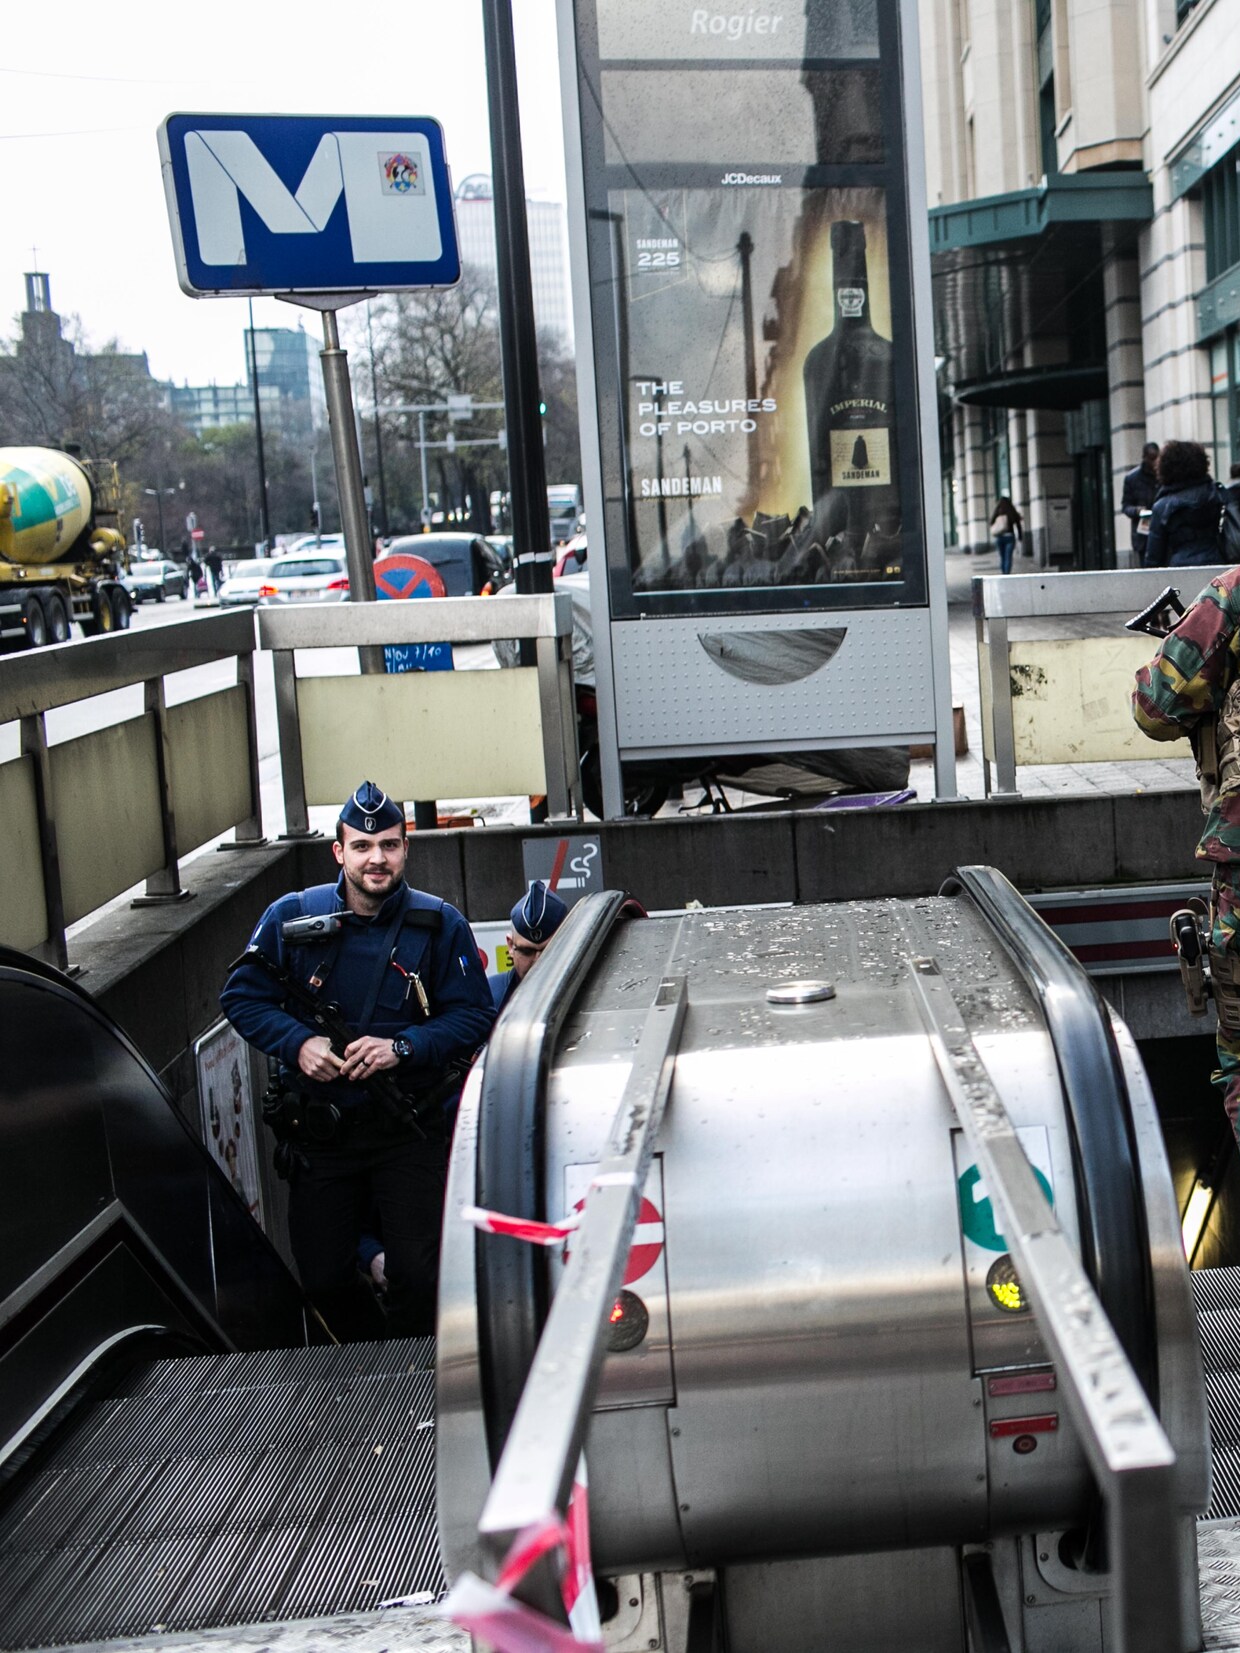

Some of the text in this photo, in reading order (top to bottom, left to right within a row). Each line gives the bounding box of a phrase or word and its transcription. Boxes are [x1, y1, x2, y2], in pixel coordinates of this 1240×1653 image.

[689, 9, 784, 40] Rogier
[721, 172, 782, 184] JCDecaux
[183, 130, 443, 266] M
[636, 239, 679, 249] SANDEMAN
[638, 252, 680, 266] 225
[636, 381, 684, 396] THE
[638, 398, 777, 416] PLEASURES
[830, 399, 888, 415] IMPERIAL
[639, 419, 757, 436] OF PORTO
[842, 469, 880, 480] SANDEMAN
[641, 475, 722, 497] SANDEMAN
